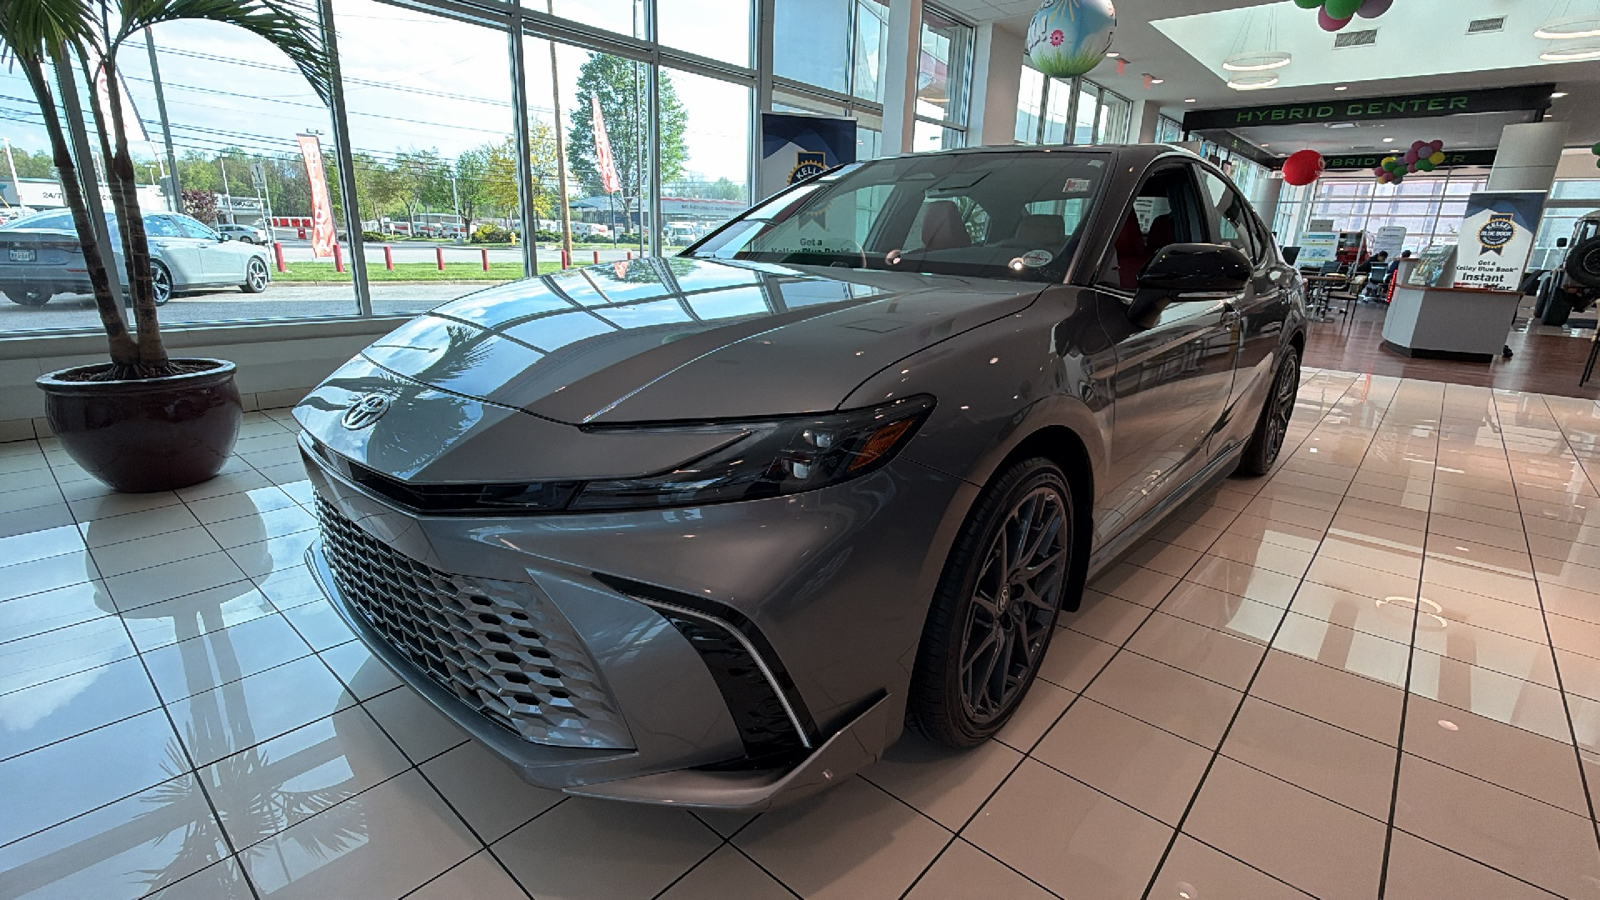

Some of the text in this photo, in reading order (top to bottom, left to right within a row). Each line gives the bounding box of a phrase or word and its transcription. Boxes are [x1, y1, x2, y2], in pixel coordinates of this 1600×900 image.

[1236, 97, 1468, 122] HYBRID CENTER
[1323, 157, 1377, 167] YBRID
[800, 237, 815, 246] Get
[1462, 272, 1504, 282] Instant
